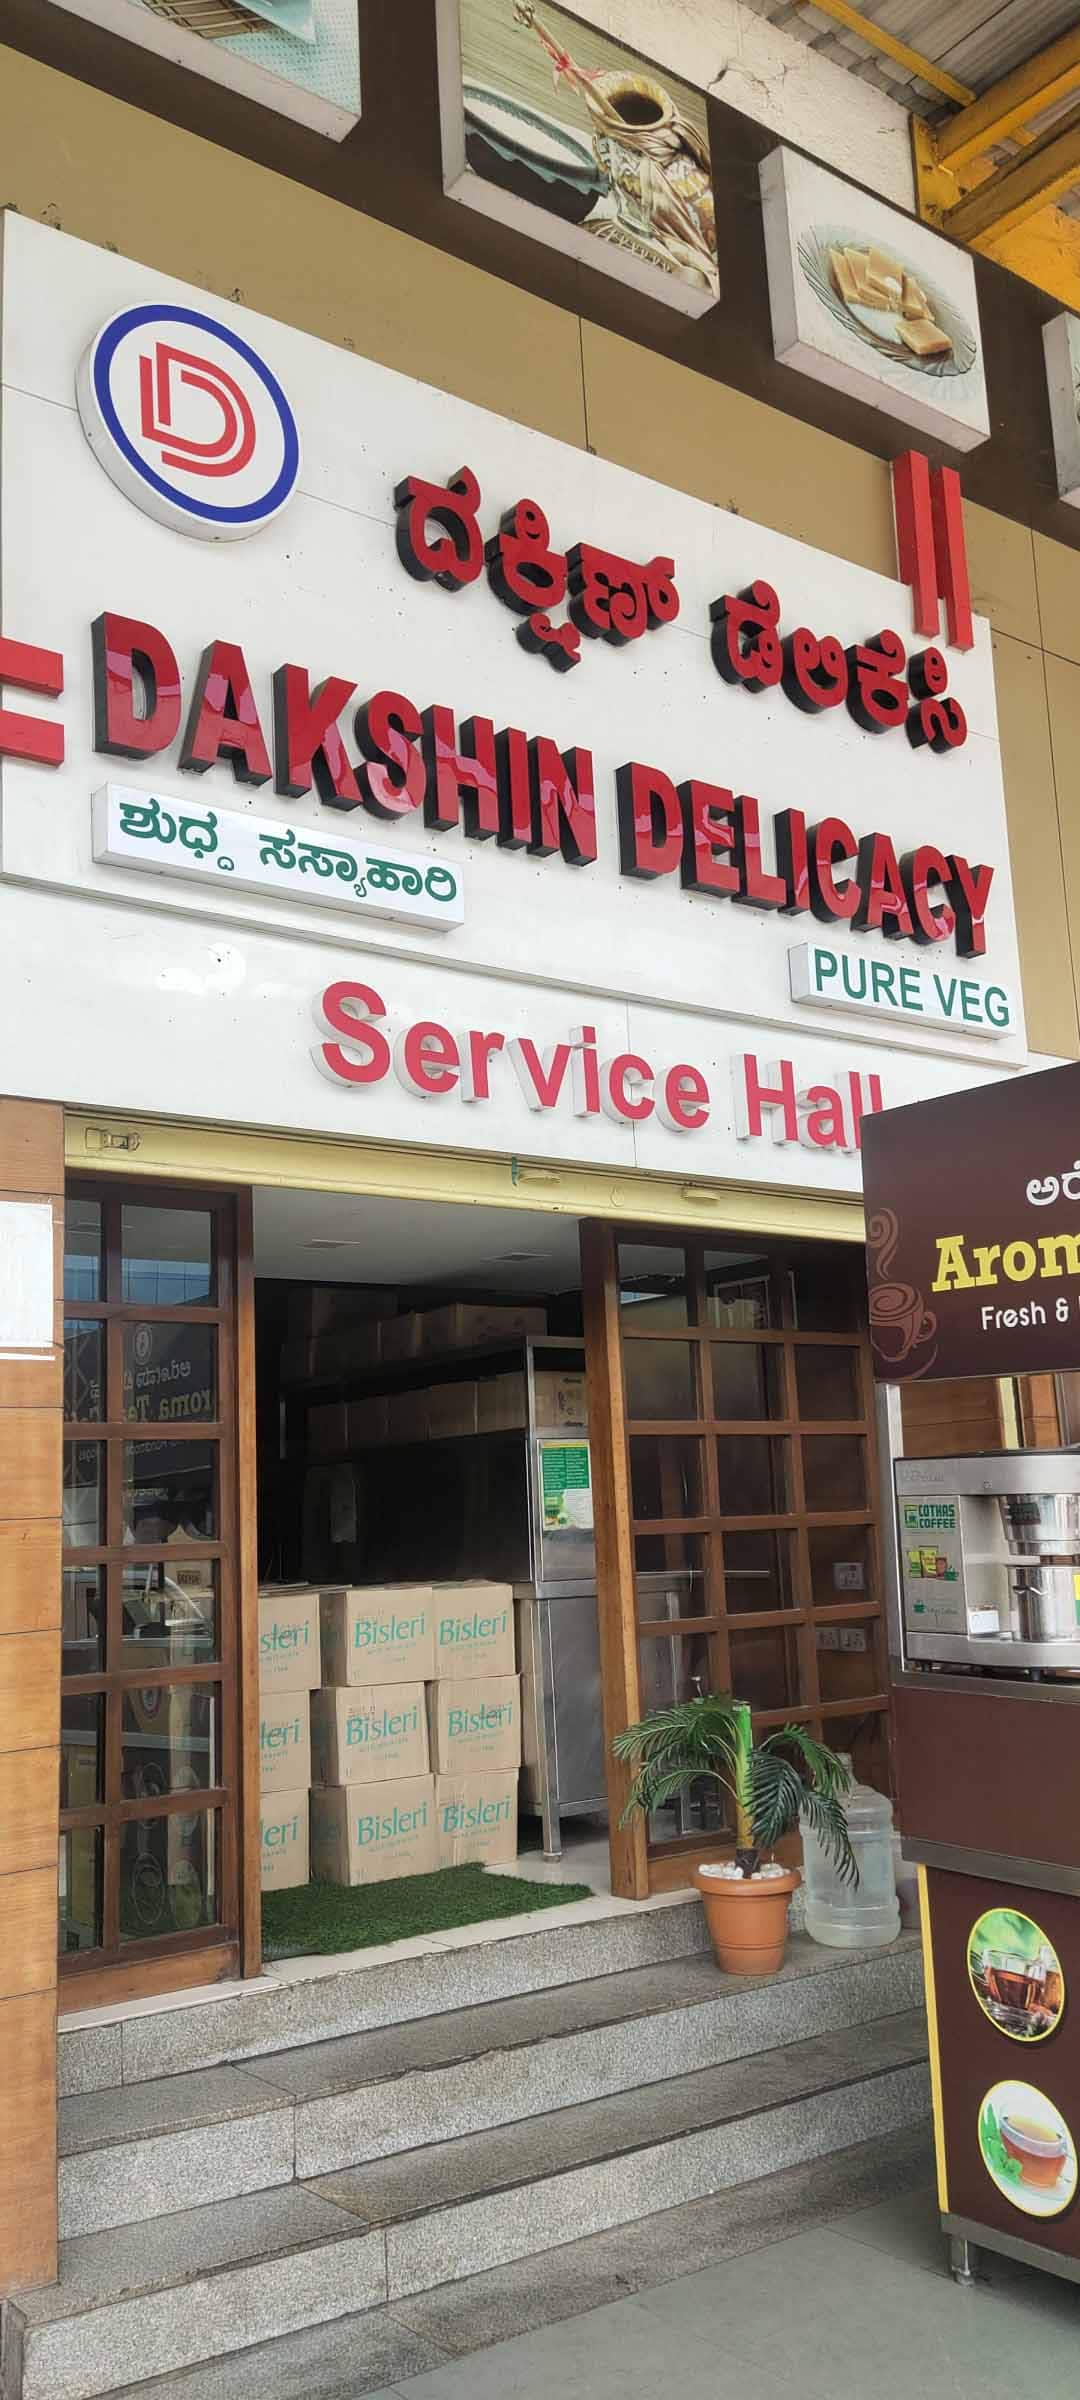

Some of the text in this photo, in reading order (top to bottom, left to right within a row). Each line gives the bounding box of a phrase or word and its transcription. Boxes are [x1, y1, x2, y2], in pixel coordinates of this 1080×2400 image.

[394, 466, 967, 752] ದಕ್ಷಿಣ್ ಡೆಲಿಕೆಸಿ
[93, 611, 993, 958] DAKSHIN DELICACY
[259, 829, 457, 902] ಸಸ್ಯಾಹಾರಿ
[814, 948, 1010, 1027] PURE VEG
[314, 980, 710, 1130] Service
[932, 1233, 1080, 1292] Arom
[981, 1297, 1069, 1330] Fresh &
[918, 1504, 955, 1517] COTHAS
[919, 1519, 956, 1529] COFFEE
[260, 1620, 309, 1654] sleri
[353, 1611, 425, 1648] Bisleri
[439, 1610, 507, 1645] Bisleri
[345, 1706, 417, 1745] Bisleri
[447, 1701, 512, 1737] Bisleri
[356, 1801, 427, 1846] Bisleri
[443, 1795, 511, 1833] Bisleri
